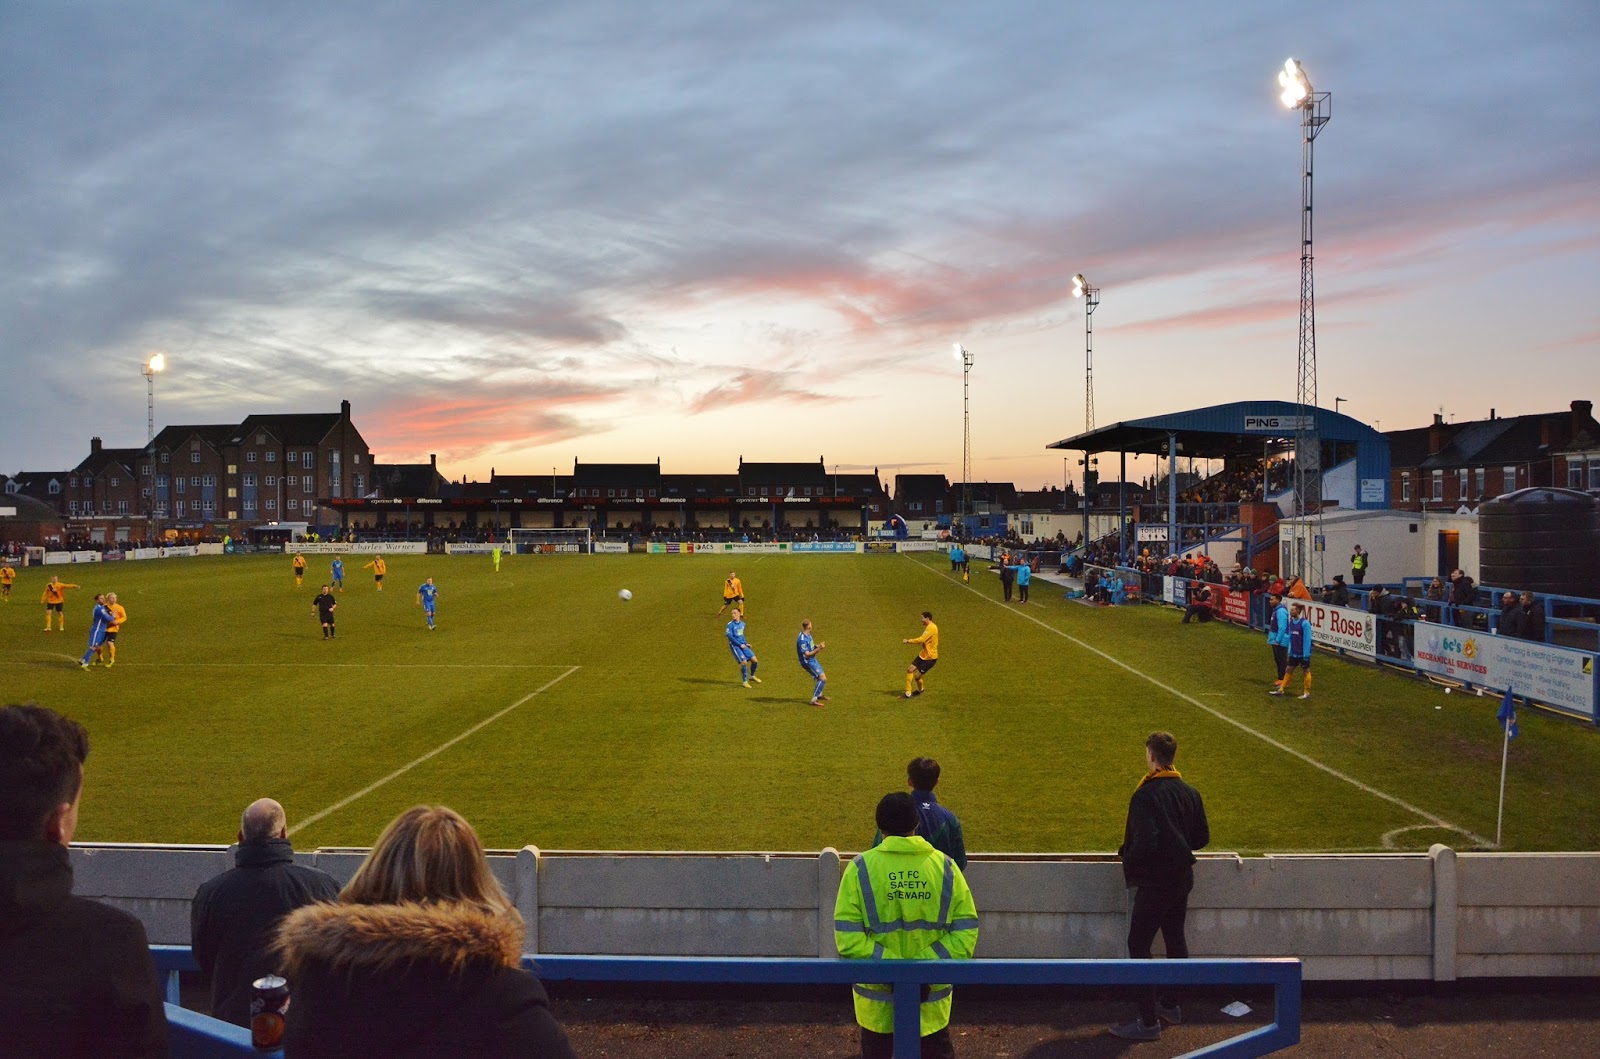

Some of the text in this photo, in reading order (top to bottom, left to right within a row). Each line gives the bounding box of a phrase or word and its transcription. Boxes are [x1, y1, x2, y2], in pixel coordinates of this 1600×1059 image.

[1246, 418, 1279, 427] PING
[1330, 610, 1362, 638] Rose
[1312, 630, 1374, 653] ECTIONERY PLANT AND EQUIPMENT
[1443, 637, 1461, 653] 6c's
[1417, 650, 1487, 674] MECHANICAL SERVICES
[1552, 654, 1574, 666] Engineer
[891, 881, 927, 889] SAFETY
[887, 890, 931, 900] STEWARD
